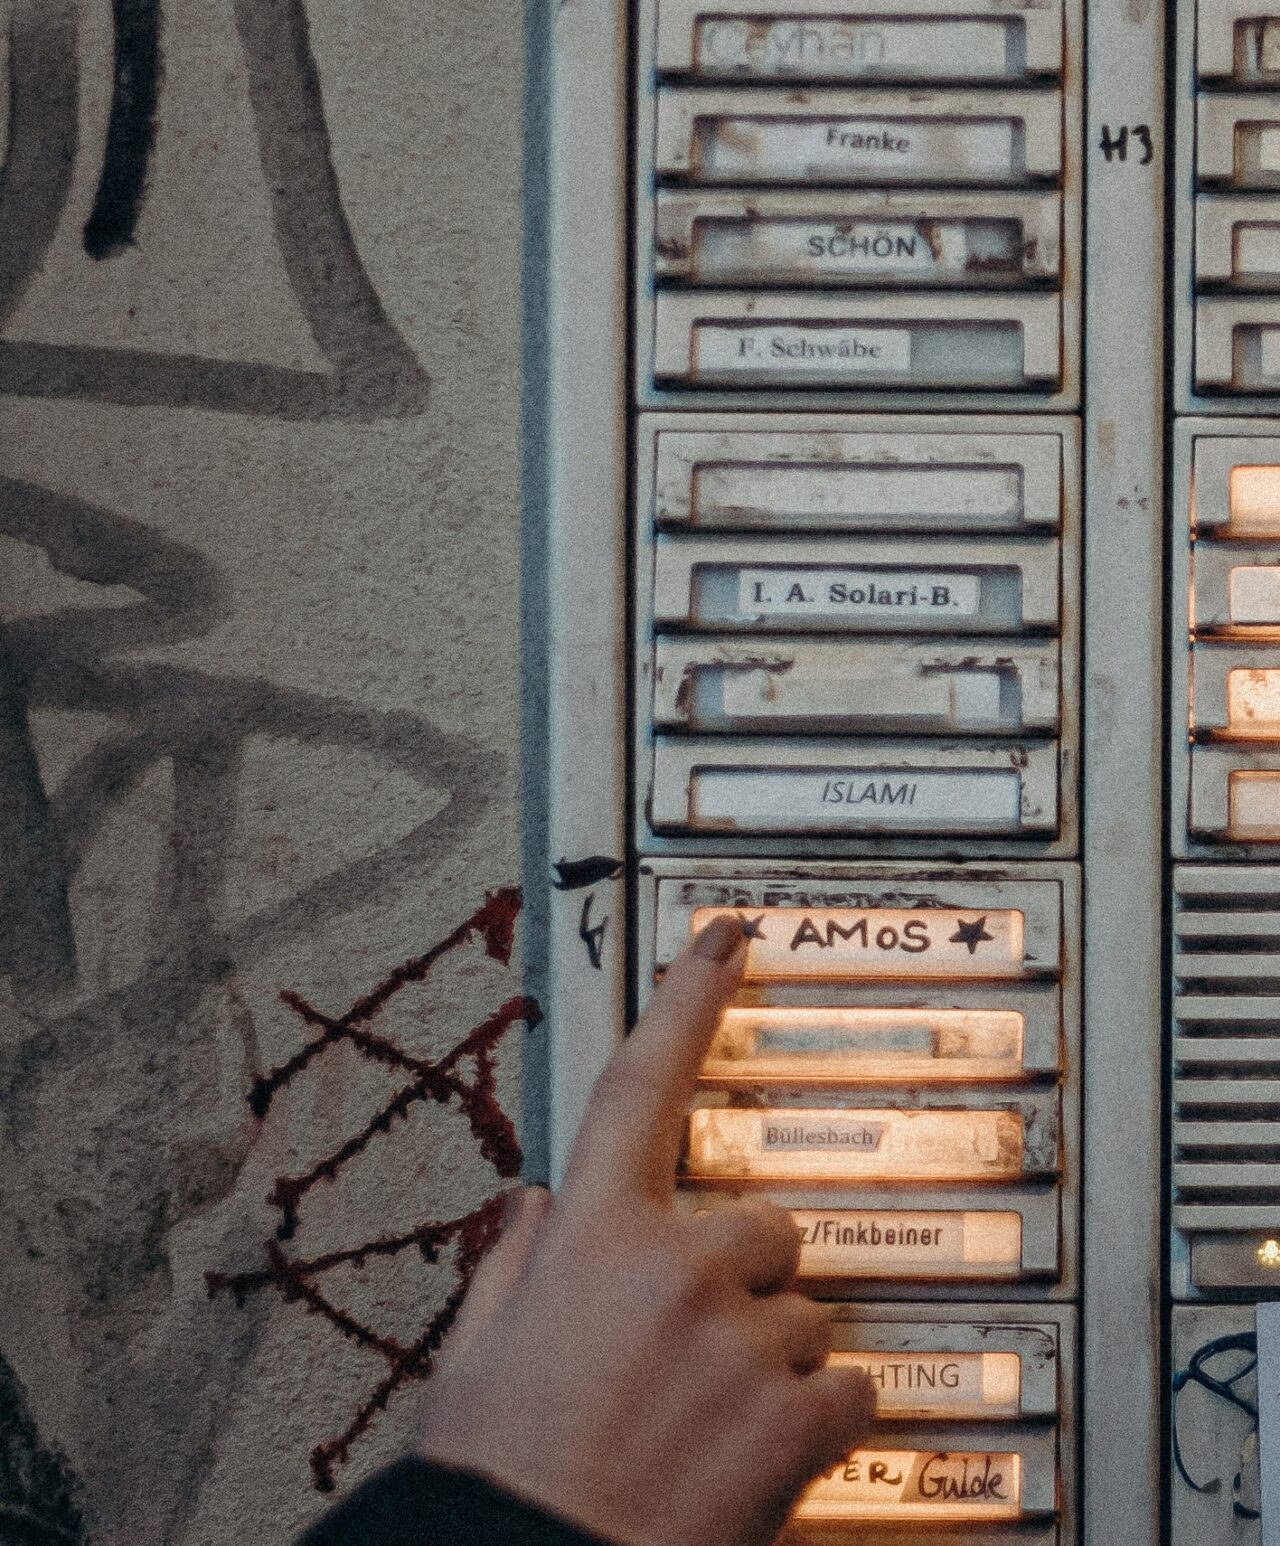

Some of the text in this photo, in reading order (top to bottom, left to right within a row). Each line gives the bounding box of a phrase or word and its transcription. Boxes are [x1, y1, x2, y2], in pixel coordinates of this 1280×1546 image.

[826, 126, 911, 152] Franke
[808, 230, 916, 258] SCHÖN
[738, 337, 882, 358] F. Schwäbe
[785, 583, 815, 603] A.
[829, 583, 960, 606] Solari-B.
[822, 781, 917, 805] ISLAMI
[766, 1127, 873, 1145] Büllesbach
[800, 1220, 943, 1246] z/Finkbeiner
[867, 1363, 960, 1389] HTING
[824, 1458, 902, 1485] ER
